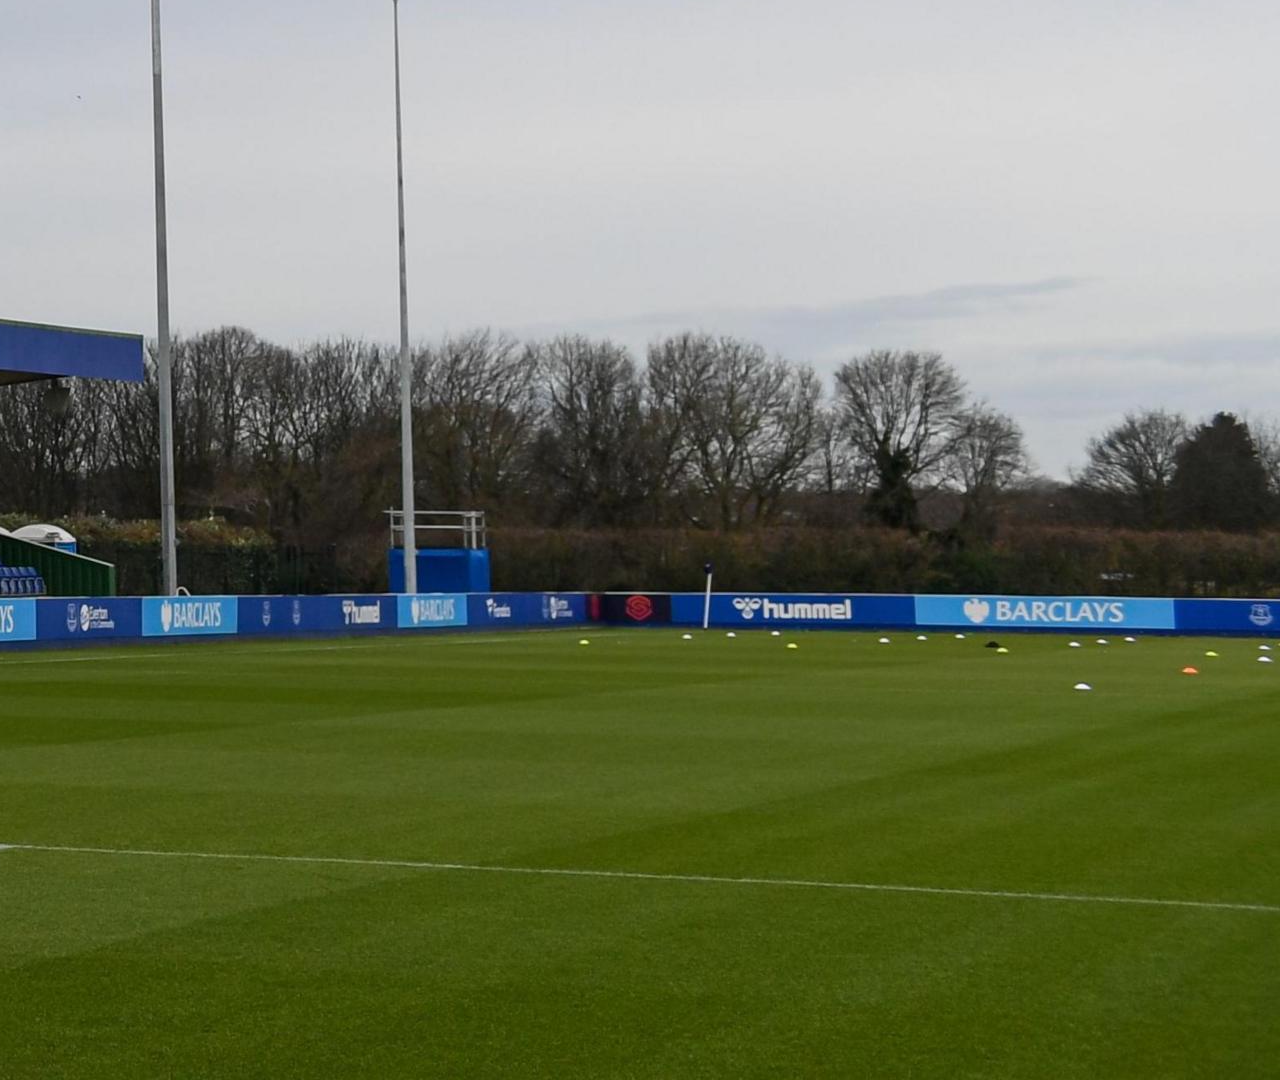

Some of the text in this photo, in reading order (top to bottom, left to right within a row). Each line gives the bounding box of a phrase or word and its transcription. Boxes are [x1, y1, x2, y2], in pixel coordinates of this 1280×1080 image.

[173, 602, 221, 628] BARCLAYS
[763, 598, 852, 619] hummel
[996, 600, 1124, 623] BARCLAYS
